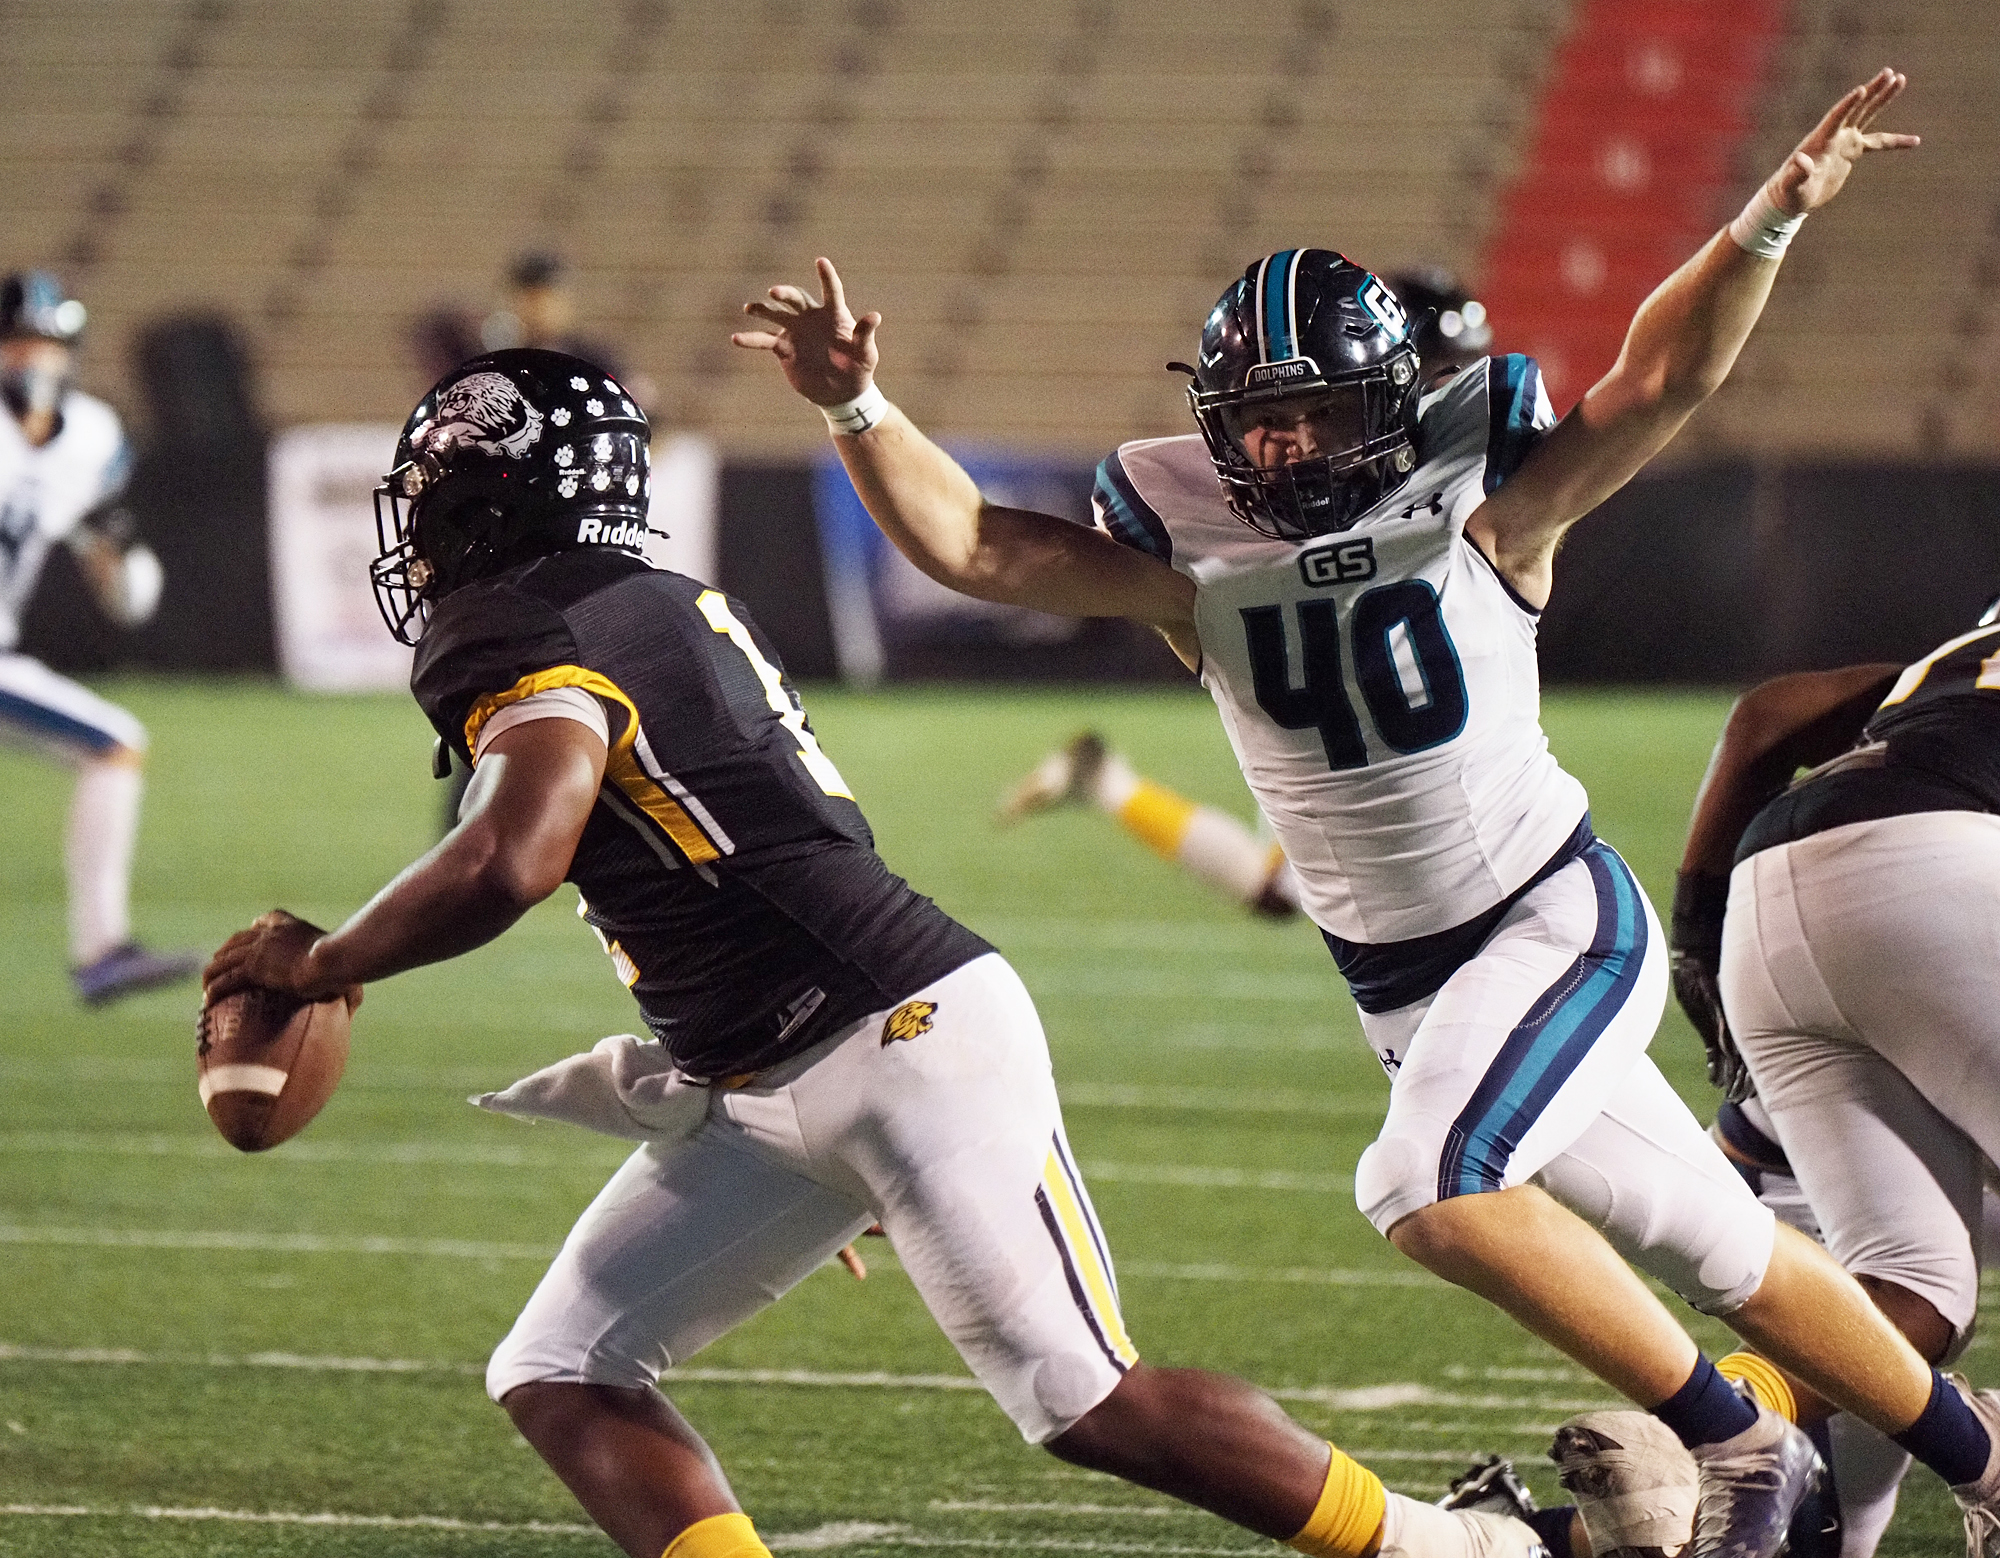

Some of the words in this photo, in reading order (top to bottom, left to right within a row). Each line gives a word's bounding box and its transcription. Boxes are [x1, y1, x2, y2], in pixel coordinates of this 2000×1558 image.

[1255, 363, 1304, 382] DOLPHINS
[577, 518, 649, 548] Riddel
[1301, 543, 1375, 584] GS
[1238, 578, 1469, 771] 40
